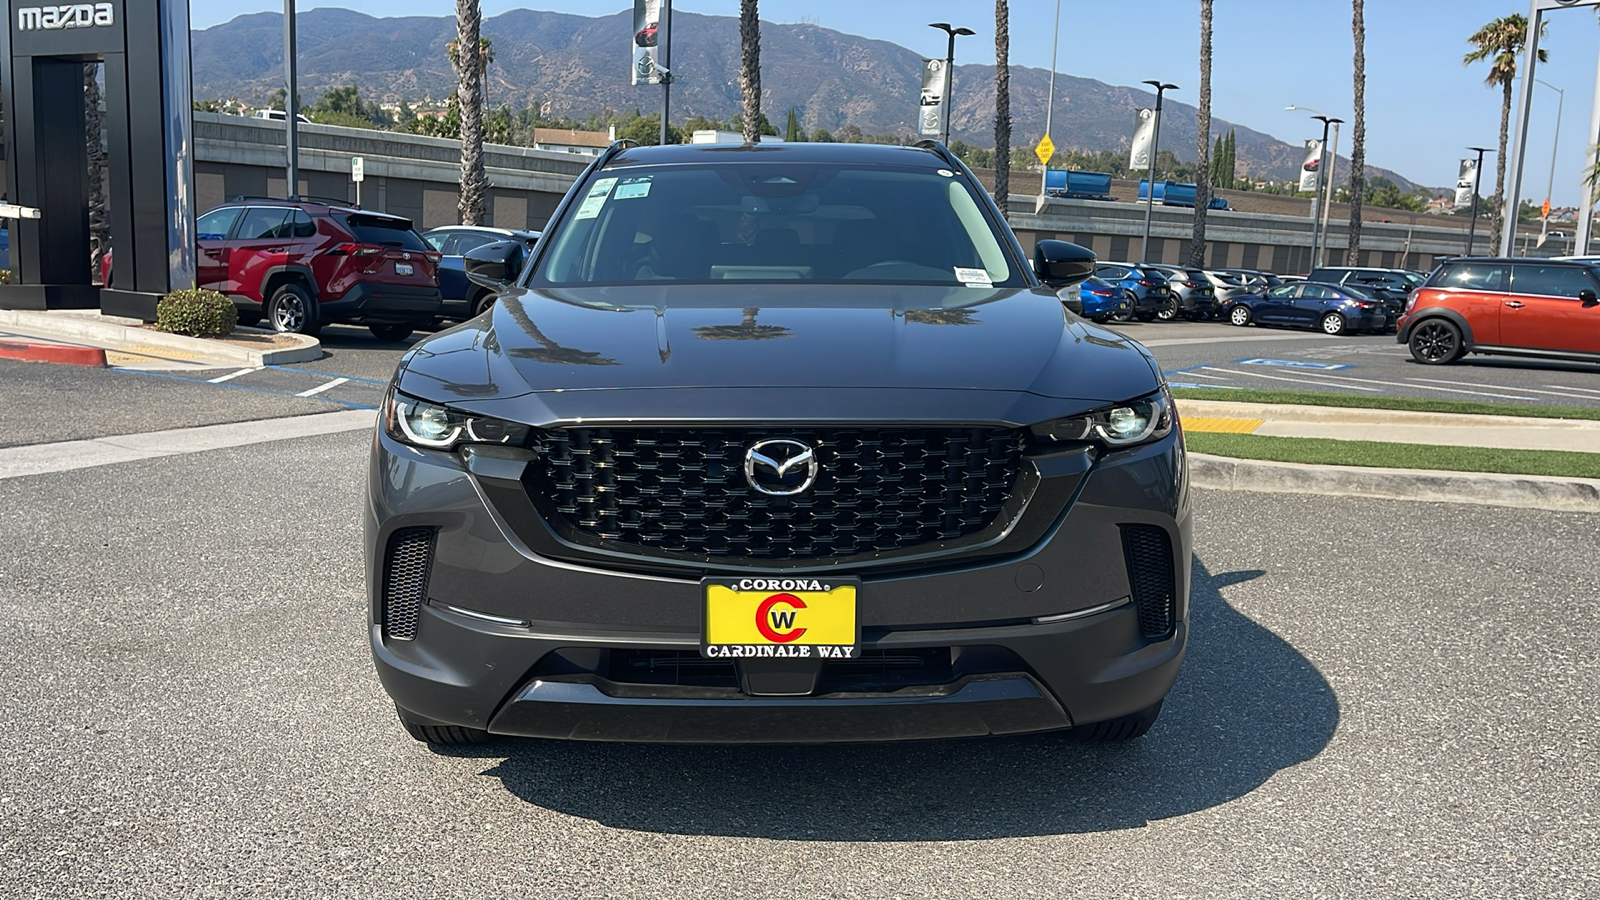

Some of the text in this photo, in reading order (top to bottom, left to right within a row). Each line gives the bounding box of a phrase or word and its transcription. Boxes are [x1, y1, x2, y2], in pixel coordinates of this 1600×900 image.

[739, 579, 823, 591] CORONA
[706, 645, 855, 658] CARDINALE WAY
